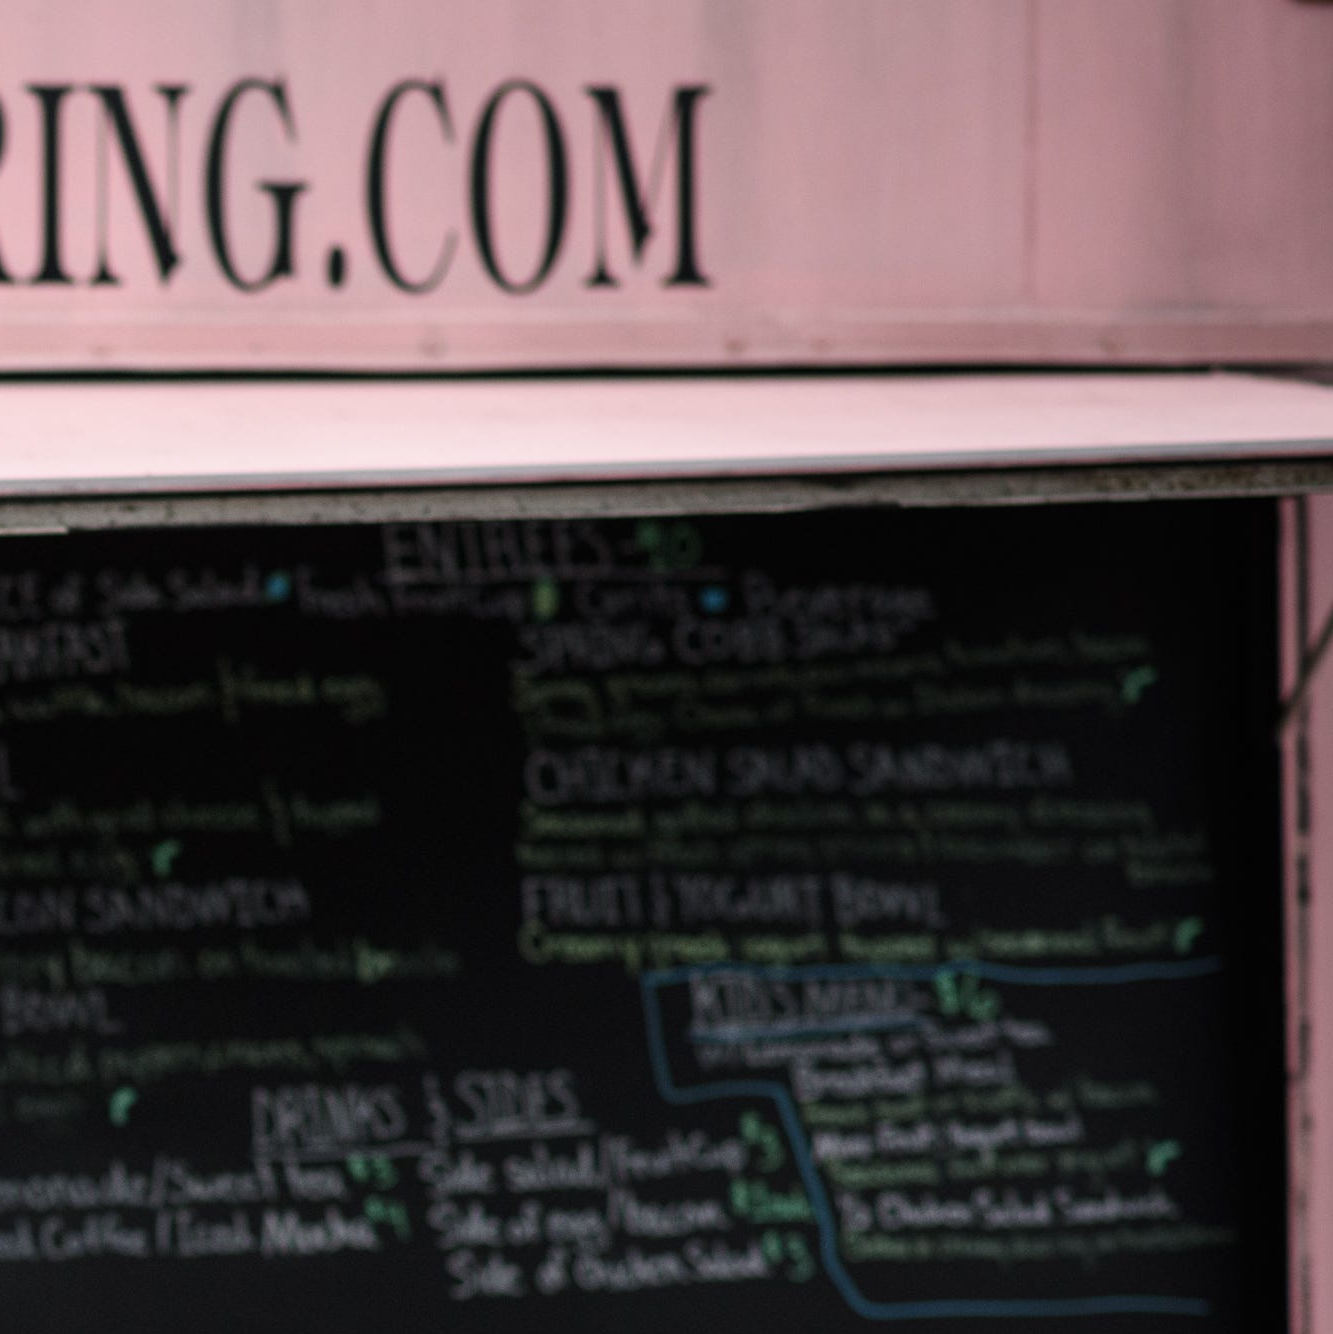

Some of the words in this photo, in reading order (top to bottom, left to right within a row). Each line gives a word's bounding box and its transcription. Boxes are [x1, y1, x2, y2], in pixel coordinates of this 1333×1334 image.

[527, 748, 715, 803] CHICKEN
[83, 878, 310, 932] SANDWICH
[1, 986, 124, 1038] BOWL
[255, 1084, 404, 1150] DRINKS
[455, 1071, 579, 1132] SIDES
